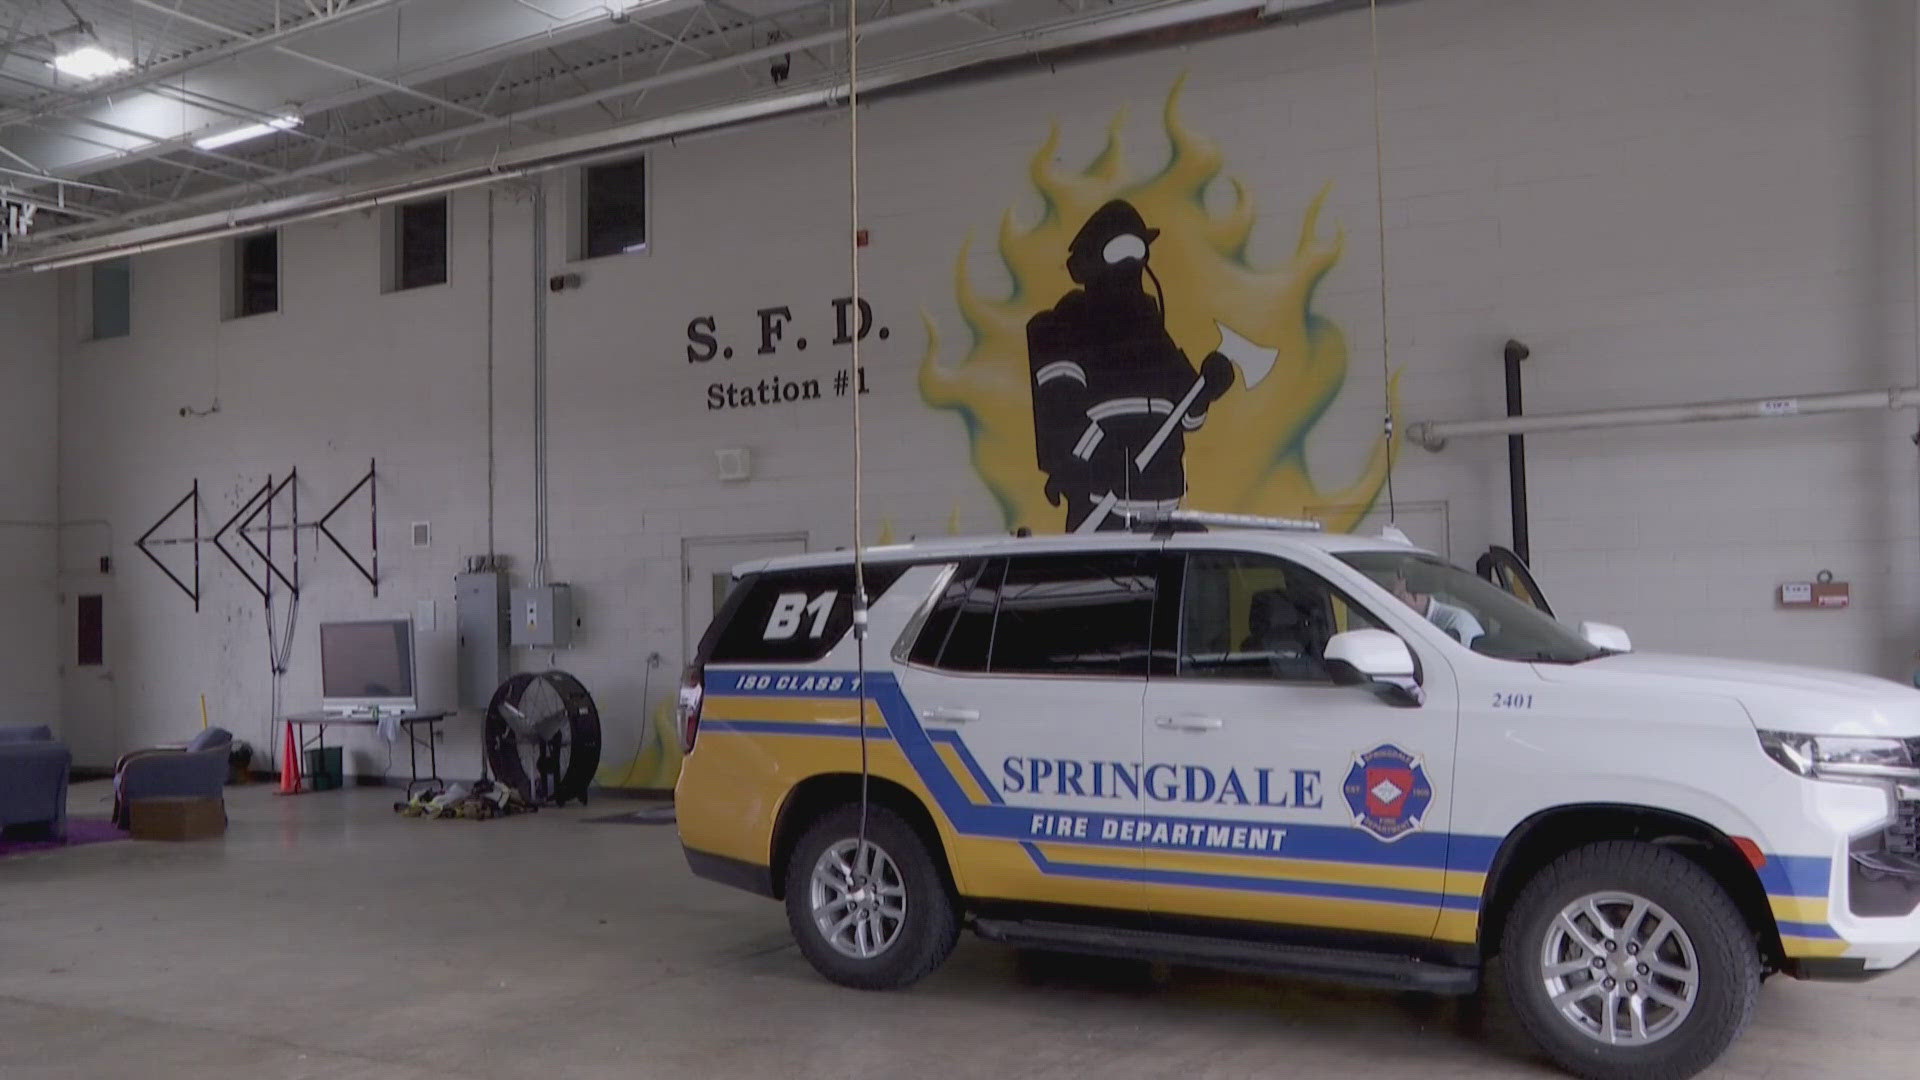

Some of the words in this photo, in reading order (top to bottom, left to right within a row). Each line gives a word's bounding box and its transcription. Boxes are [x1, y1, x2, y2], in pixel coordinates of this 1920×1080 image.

[687, 315, 733, 364] S.
[757, 306, 807, 355] F.
[831, 297, 890, 346] D.
[707, 376, 821, 411] Station
[833, 366, 870, 397] #1
[762, 589, 838, 640] B1
[735, 675, 772, 690] ISO
[775, 676, 842, 691] CLASS
[851, 678, 862, 691] 1
[1491, 692, 1533, 709] 2401
[1003, 756, 1323, 809] SPRINGDALE
[1030, 814, 1089, 838] FIRE
[1101, 819, 1288, 851] DEPARTMENT
